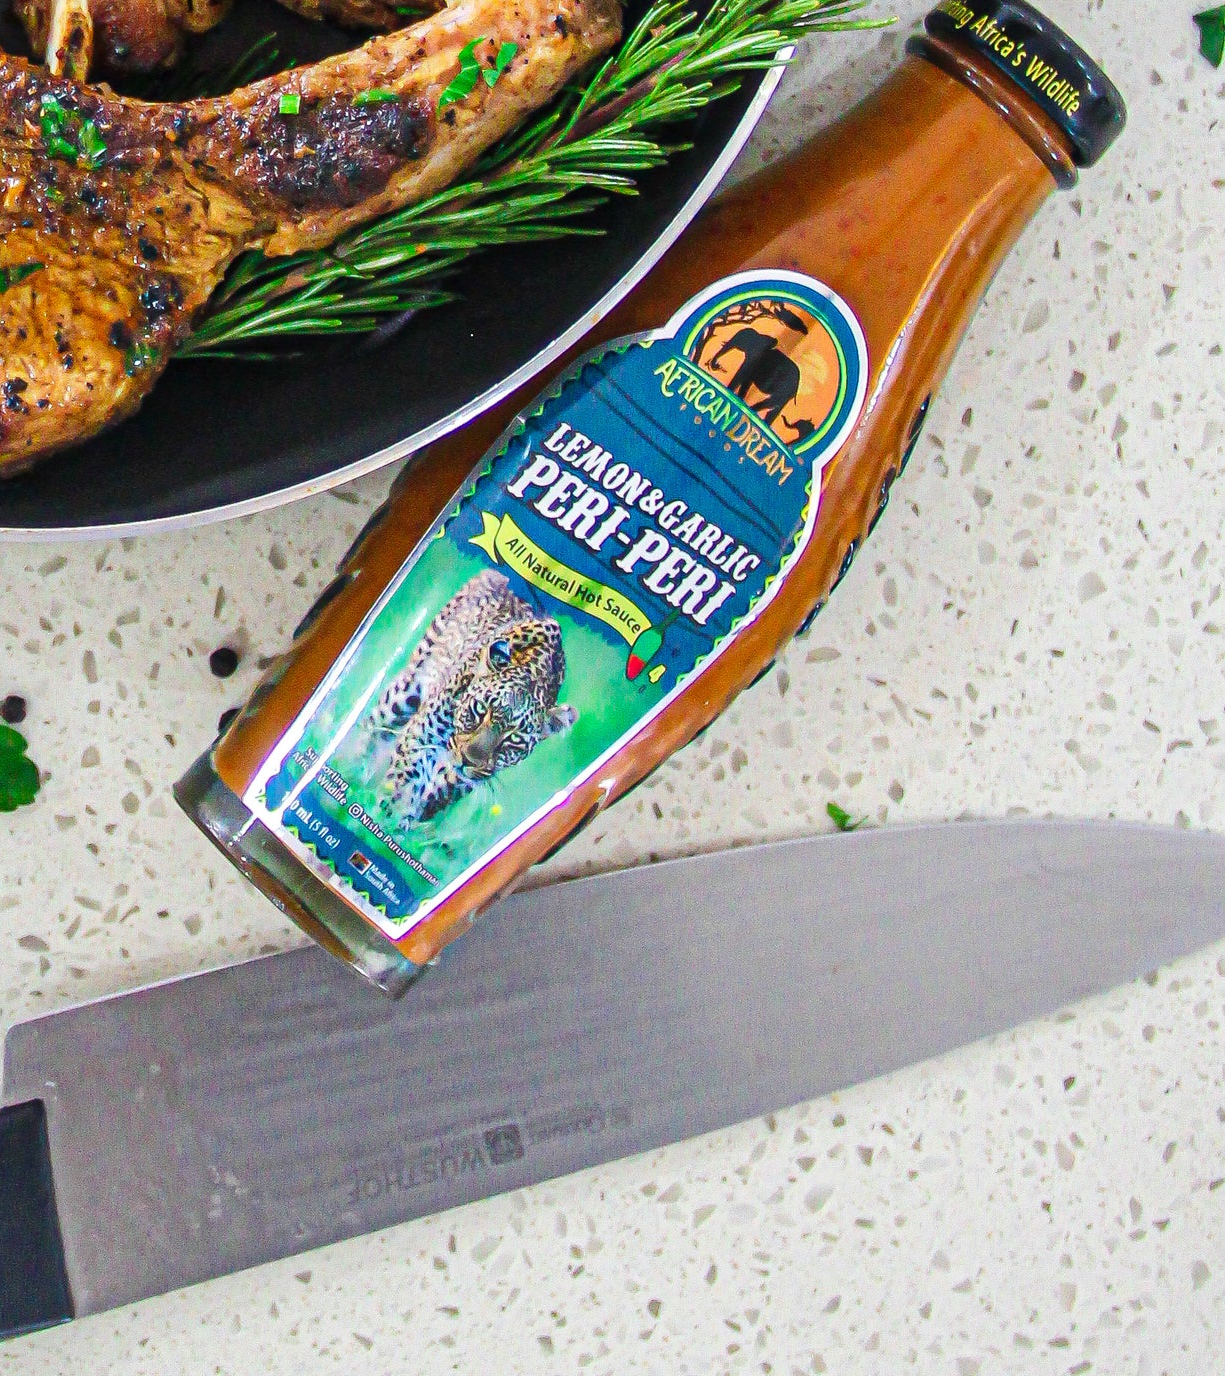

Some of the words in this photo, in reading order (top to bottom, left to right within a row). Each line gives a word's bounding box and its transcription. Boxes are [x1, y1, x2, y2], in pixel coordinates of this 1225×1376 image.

[970, 15, 1027, 67] Africa's
[1026, 55, 1080, 117] Wildlife
[654, 358, 739, 431] AFRICAN
[727, 414, 794, 486] DREAM
[506, 454, 736, 625] PERI-PERI
[504, 537, 523, 559] All
[522, 553, 574, 594] Natural
[576, 583, 603, 608] Hot
[604, 598, 641, 634] Sauce
[282, 791, 298, 811] 10
[295, 805, 313, 824] mL
[316, 773, 348, 806] Wildlife
[363, 874, 384, 891] South
[370, 863, 388, 883] Made
